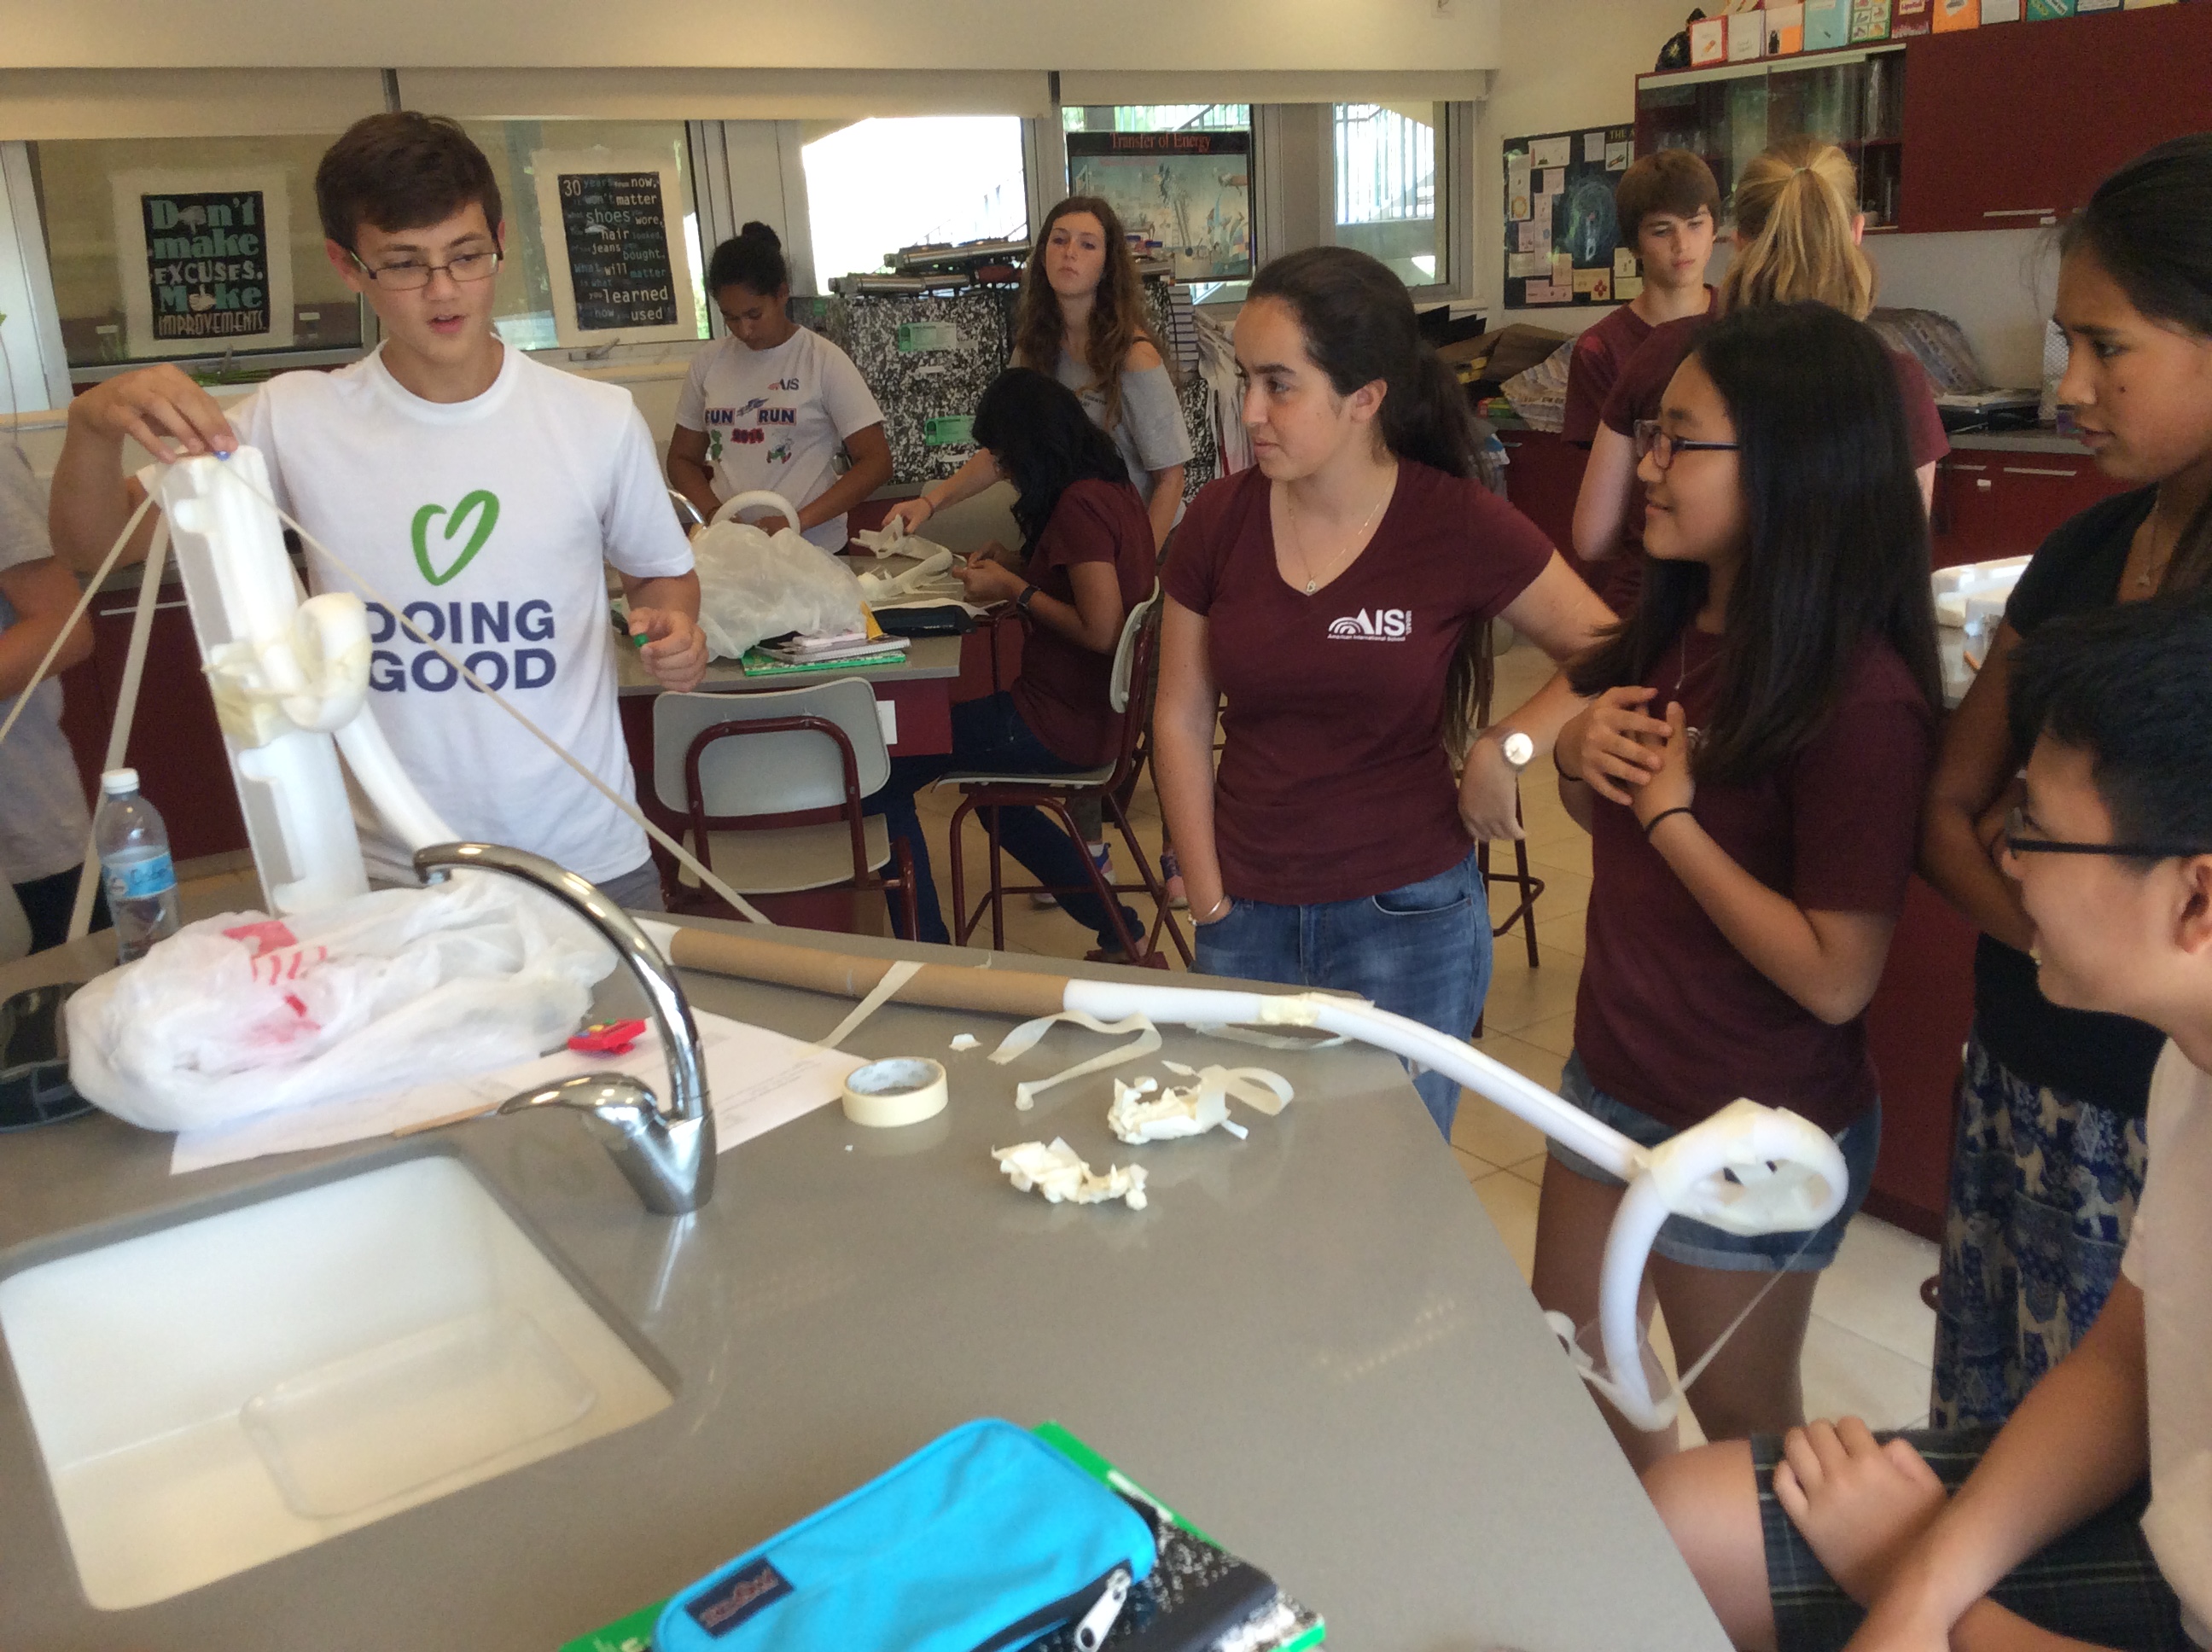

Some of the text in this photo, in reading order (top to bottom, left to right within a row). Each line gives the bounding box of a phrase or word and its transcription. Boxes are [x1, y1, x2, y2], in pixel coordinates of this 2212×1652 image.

[1111, 132, 1212, 152] Transfer of Energy
[563, 179, 582, 197] 30
[584, 193, 614, 205] won't
[615, 194, 657, 206] matter
[149, 197, 256, 230] Dn't
[585, 208, 631, 224] shoes
[153, 227, 259, 259] make
[601, 228, 630, 240] hair
[591, 243, 621, 255] jeans
[623, 249, 666, 261] bought.
[154, 260, 264, 285] EXCUSES.
[604, 263, 627, 276] will
[630, 268, 666, 278] matter
[159, 283, 263, 313] Mke
[602, 285, 668, 304] learned
[632, 306, 663, 321] used
[779, 378, 800, 391] AIS
[758, 410, 795, 424] RUN
[365, 599, 556, 644] DOING
[1350, 607, 1406, 637] AIS
[368, 648, 557, 694] GOOD
